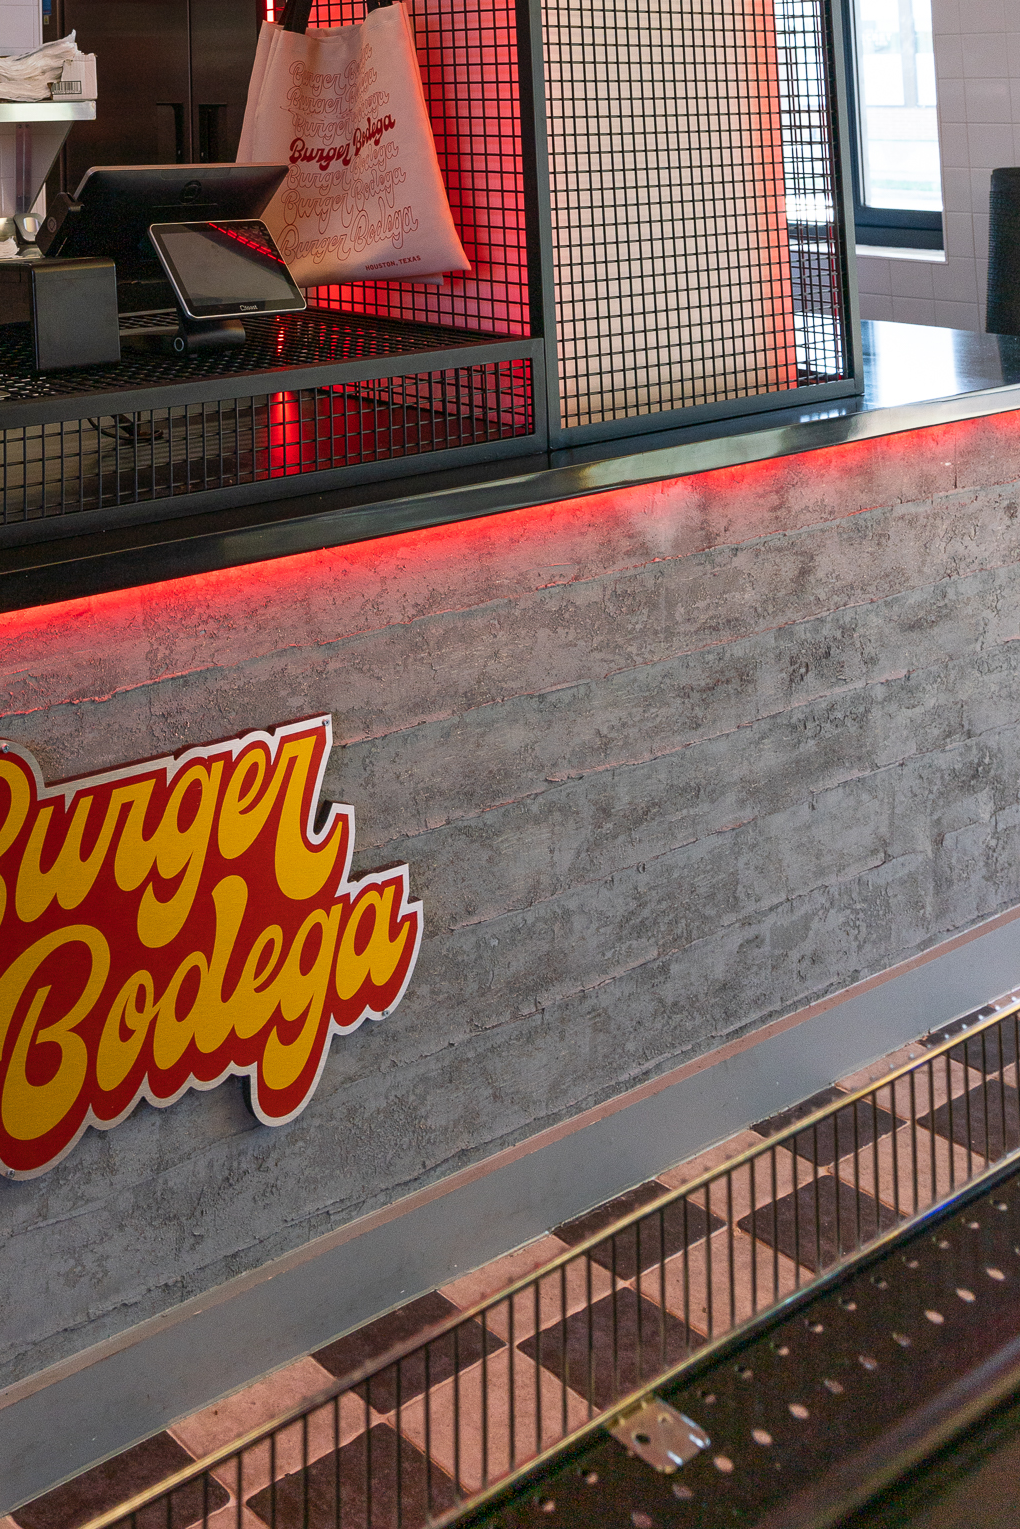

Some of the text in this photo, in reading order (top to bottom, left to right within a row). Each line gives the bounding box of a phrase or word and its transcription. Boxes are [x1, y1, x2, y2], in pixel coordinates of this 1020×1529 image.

[289, 114, 396, 171] Burger Bodega
[281, 166, 407, 235] Burger Bodega
[287, 163, 352, 196] Burger
[277, 196, 418, 266] Burger Bodega
[399, 254, 422, 266] TEXAS
